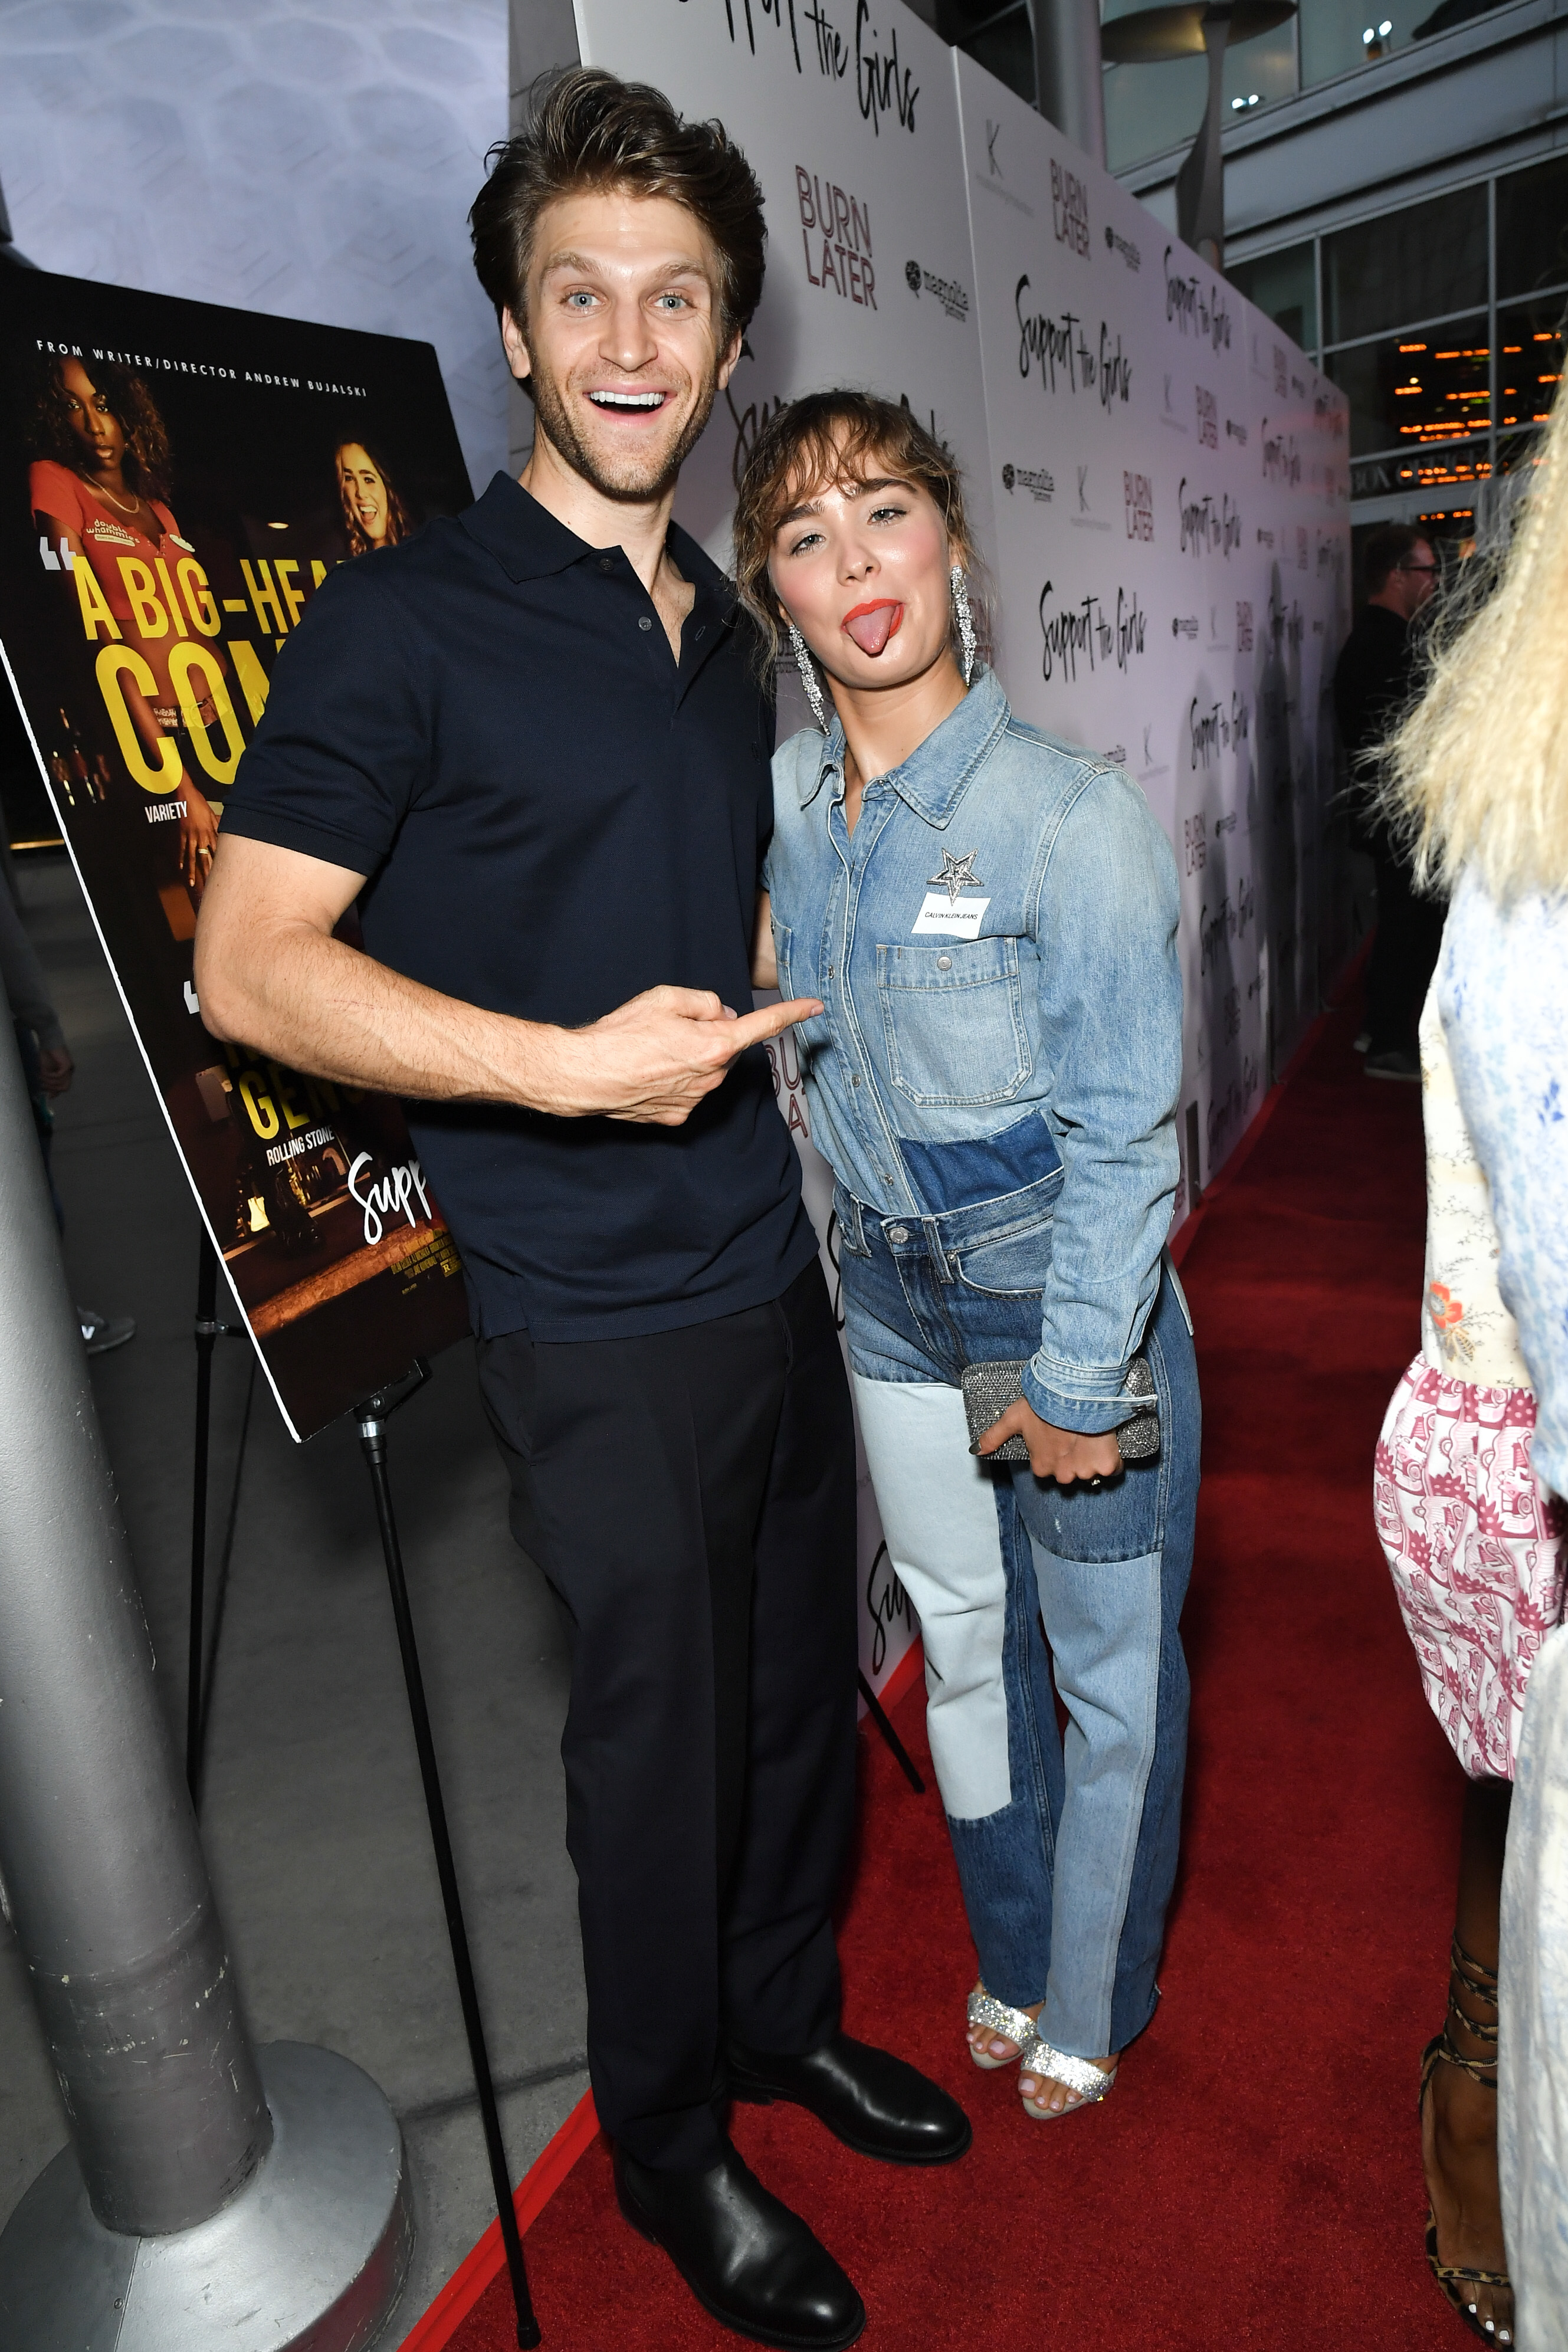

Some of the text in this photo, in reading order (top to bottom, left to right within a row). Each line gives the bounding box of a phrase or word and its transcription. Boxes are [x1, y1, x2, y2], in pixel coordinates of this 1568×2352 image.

[857, 0, 919, 137] Girls
[795, 165, 872, 258] BURN
[803, 228, 877, 310] LATER
[37, 340, 367, 397] FROM WRITER/DIRECTOR ANDREW BUJALSKI
[1015, 274, 1080, 393] Support
[1100, 321, 1133, 415] Girls
[1123, 470, 1153, 511] BURN
[86, 526, 141, 544] whammies
[94, 518, 127, 534] double
[1126, 501, 1154, 543] LATER
[1039, 580, 1098, 683] Support
[1117, 586, 1147, 674] Girls
[144, 800, 188, 824] VARIETY
[265, 1123, 335, 1167] ROLLING STONE
